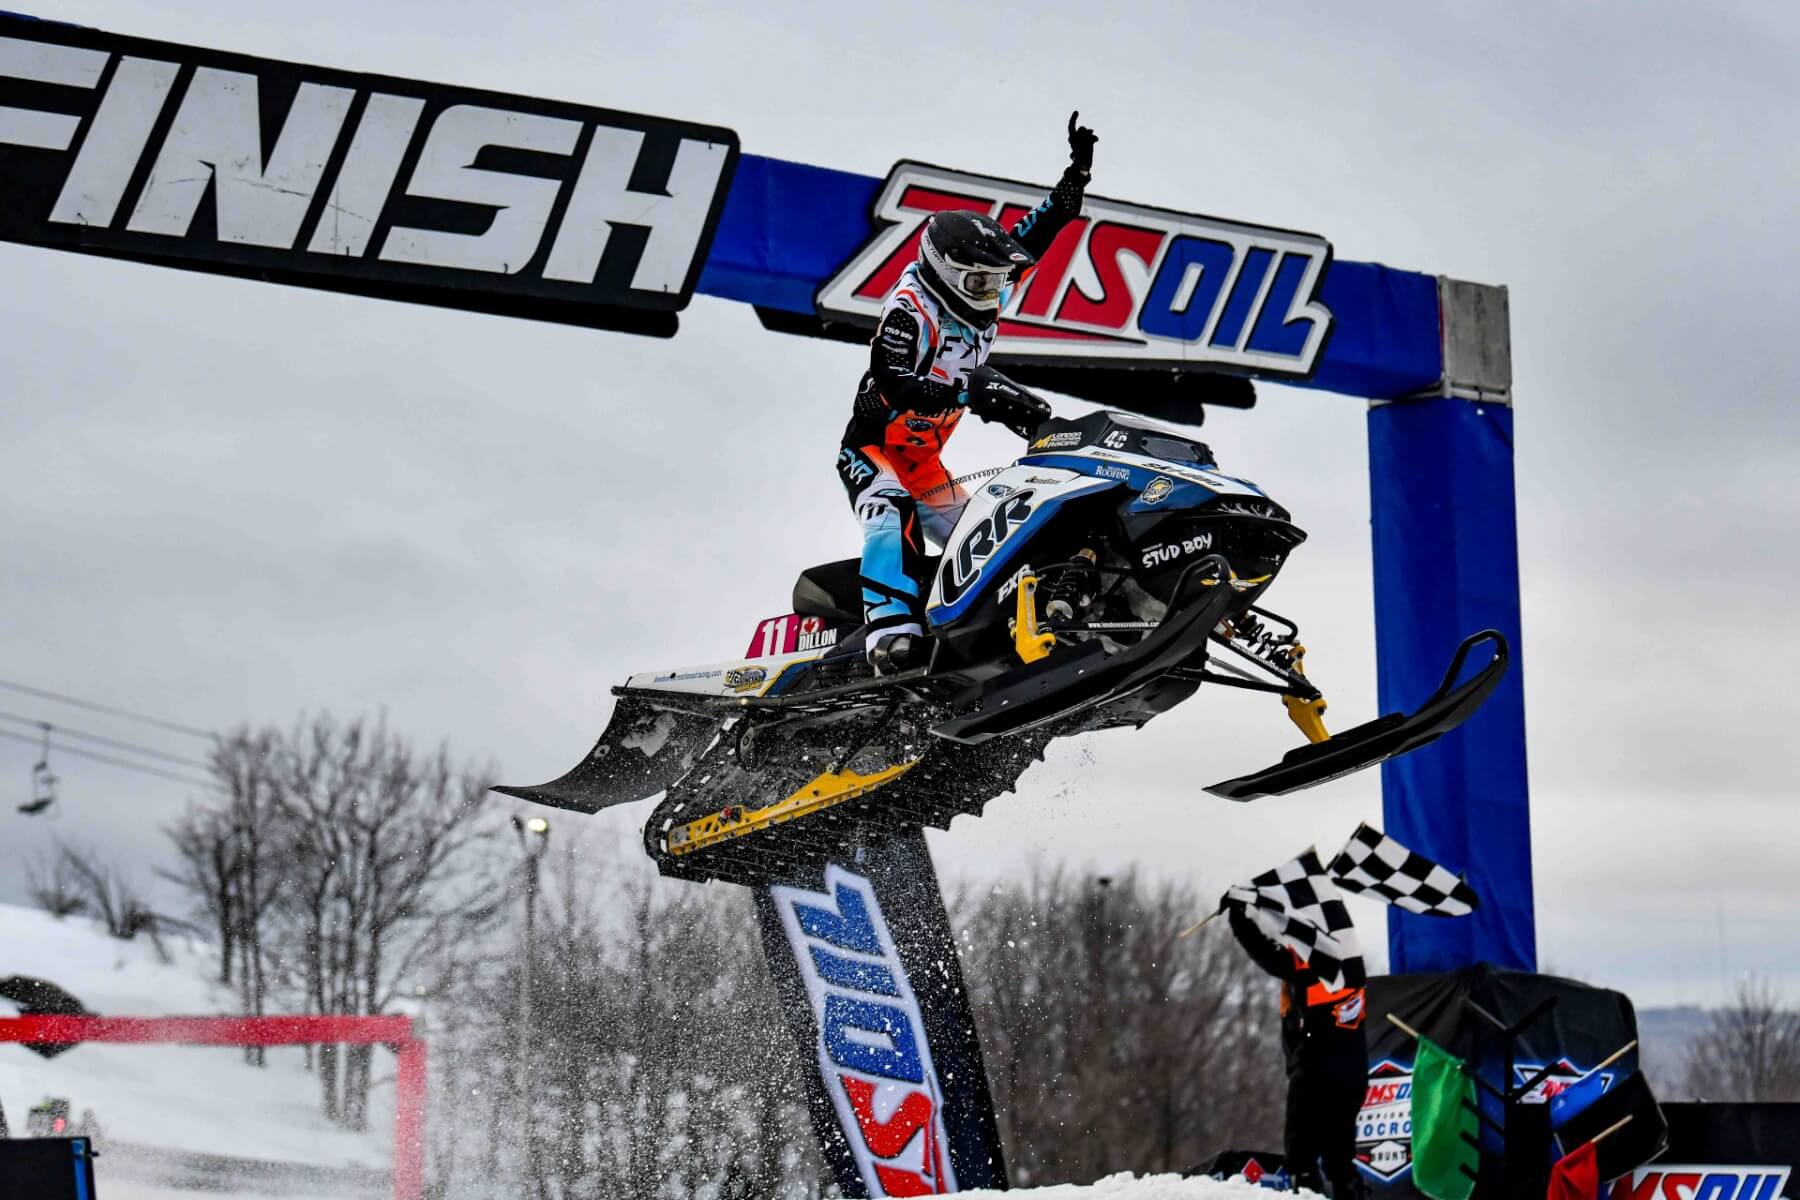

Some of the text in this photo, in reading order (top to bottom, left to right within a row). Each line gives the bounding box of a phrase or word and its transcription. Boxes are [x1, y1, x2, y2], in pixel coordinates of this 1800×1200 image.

[1142, 545, 1181, 569] STUD
[1182, 532, 1213, 555] BOY
[798, 628, 837, 651] DILLON
